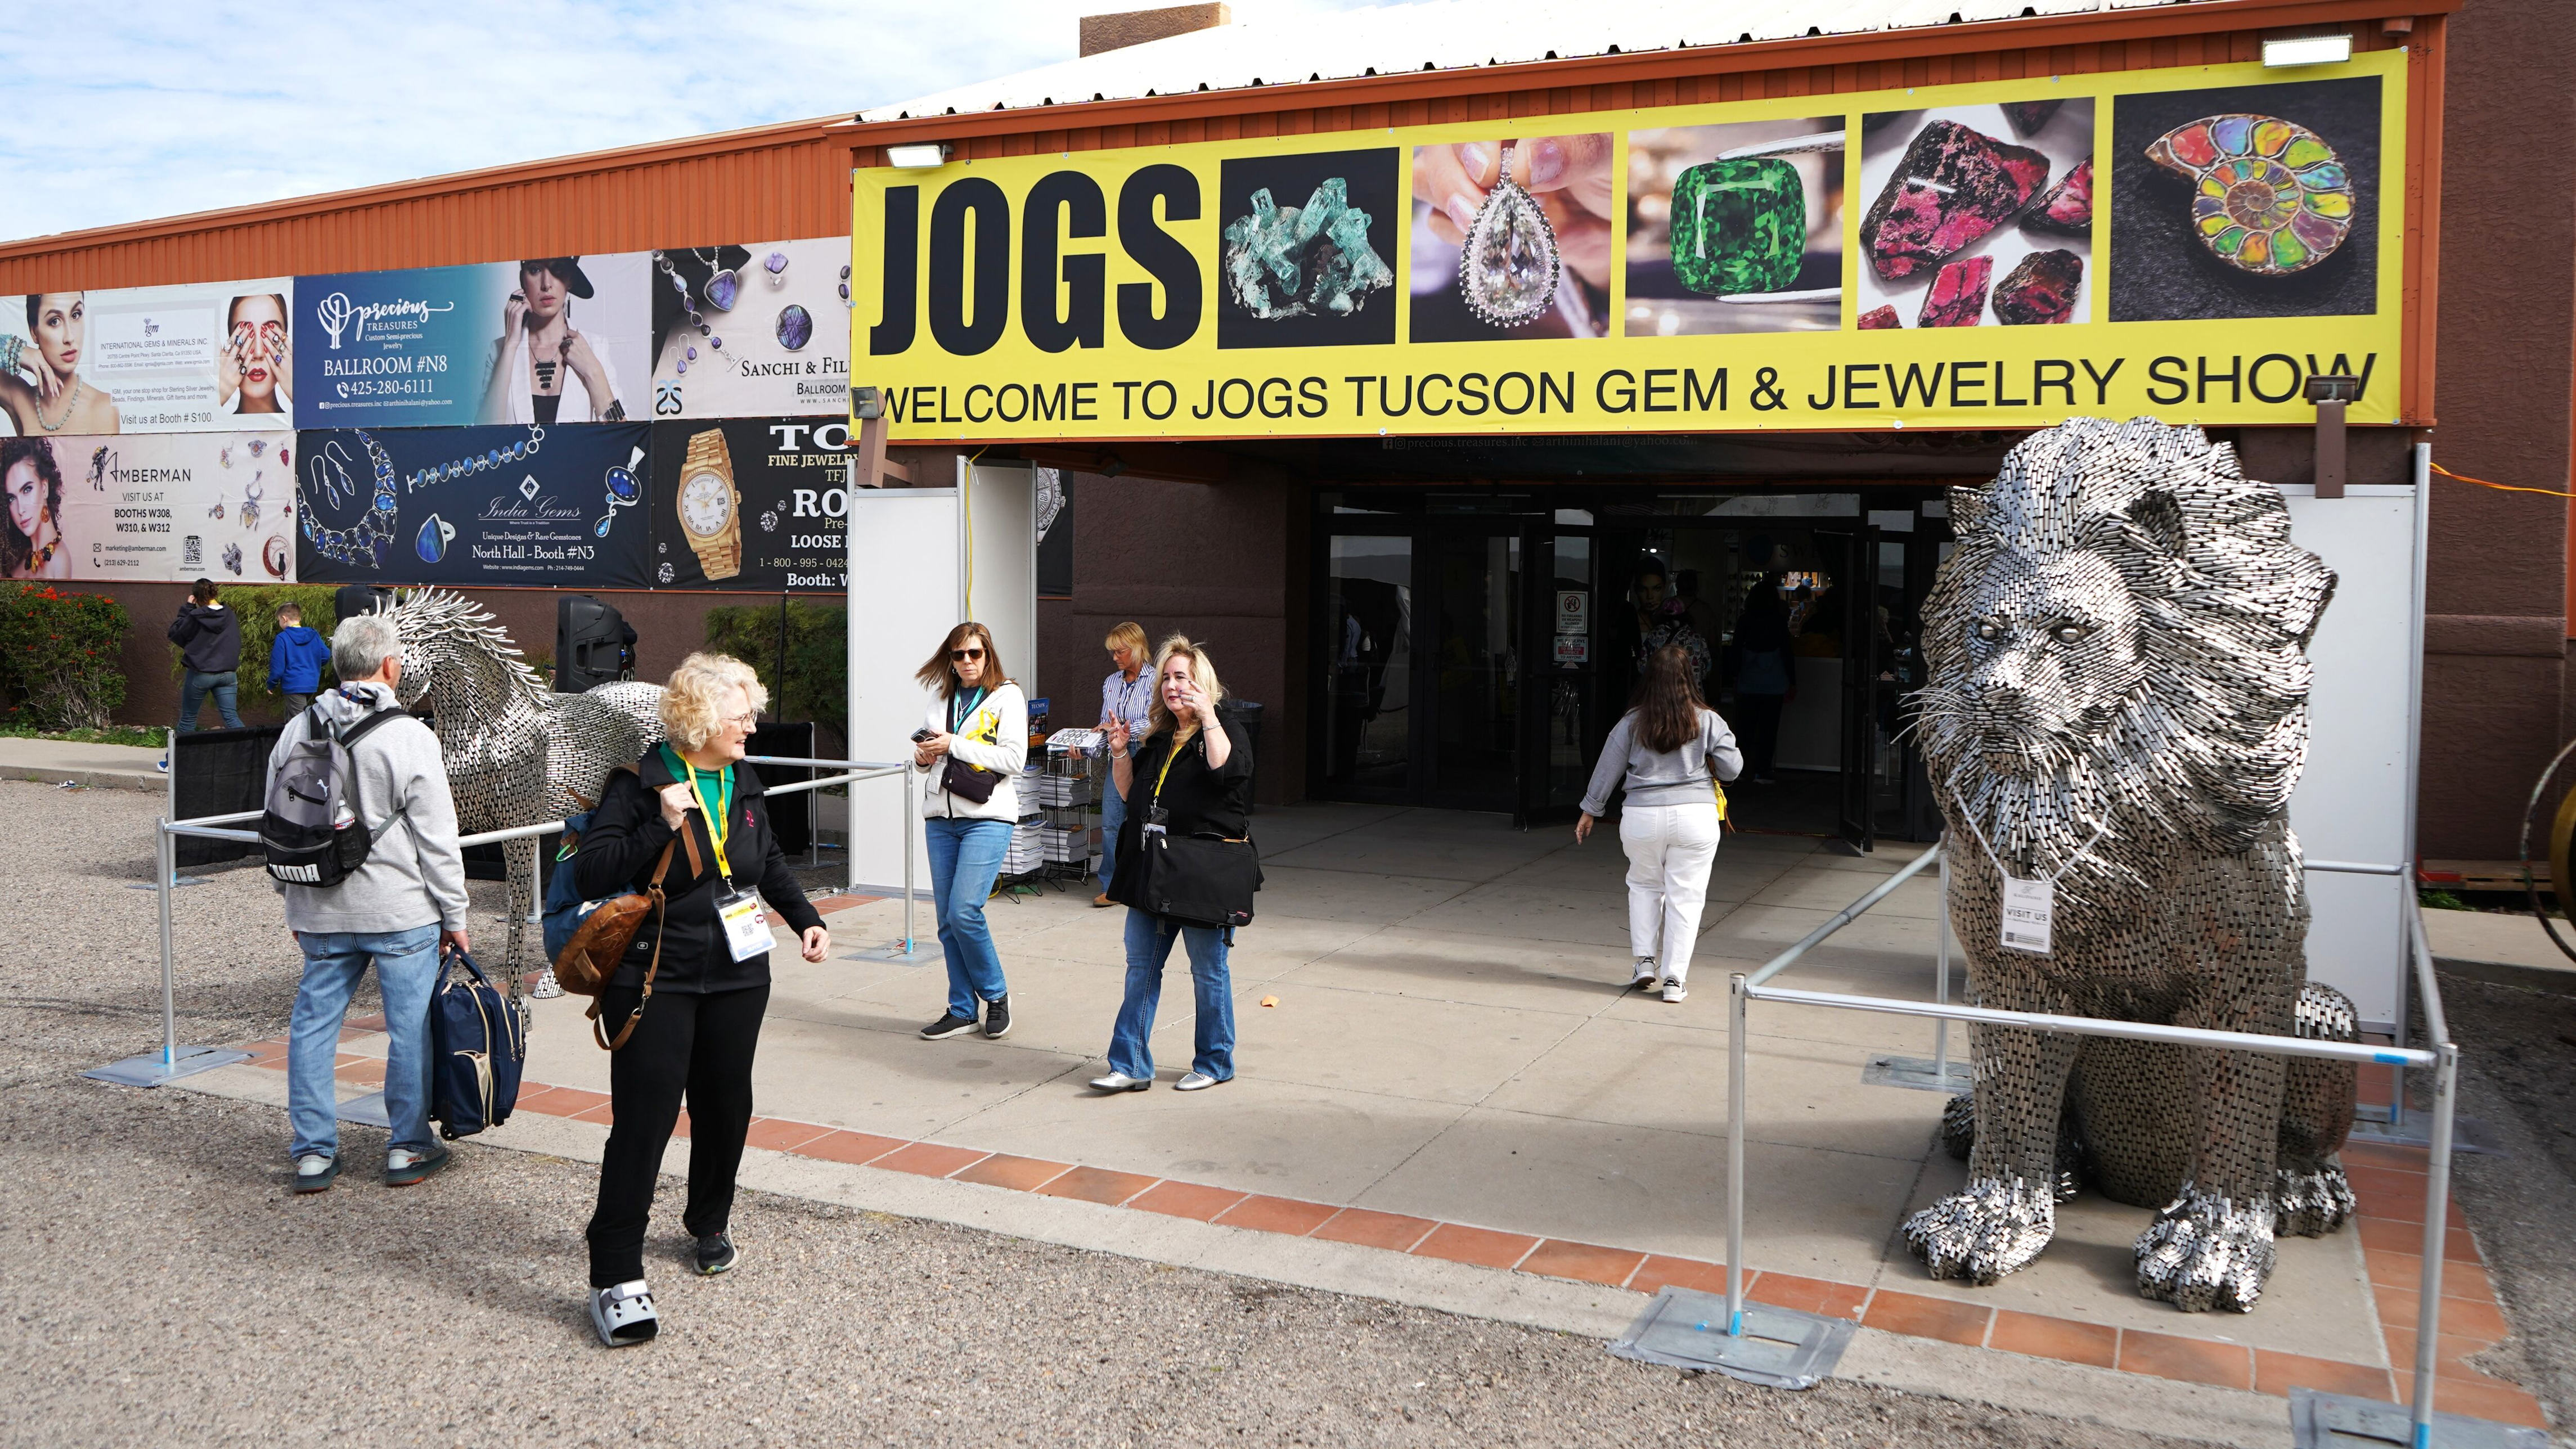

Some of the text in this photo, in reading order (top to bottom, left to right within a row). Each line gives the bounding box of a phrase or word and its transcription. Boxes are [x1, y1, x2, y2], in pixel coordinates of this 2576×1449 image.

[870, 164, 1202, 356] JOGS
[357, 298, 453, 341] precious
[367, 321, 417, 331] TREASURES
[145, 325, 159, 338] igm
[324, 355, 447, 376] BALLROOM #N8
[741, 357, 850, 376] SANCHI & FIL
[351, 379, 433, 395] 425-280-6111
[797, 382, 846, 395] BALLROOM
[882, 353, 2377, 423] WELCOME TO JOGS TUCSON GEM & JEWELRY SHOW
[330, 401, 382, 410] precious.treasures.inc
[120, 415, 137, 424] Visit
[150, 415, 157, 424] at
[159, 413, 182, 423] Booth
[184, 413, 189, 422] #
[191, 412, 214, 422] S100.
[768, 454, 798, 466] FINE
[105, 452, 191, 483] AMBERMAN
[122, 493, 164, 501] VISIT US AT
[478, 496, 582, 518] India Gems
[115, 509, 172, 519] BOOTHS W308,
[116, 524, 170, 533] W310, & W312
[483, 532, 503, 541] Unique
[505, 532, 527, 542] Designs
[528, 532, 534, 540] &
[550, 532, 582, 541] Gemstones
[791, 534, 841, 548] LOOSE
[472, 545, 501, 559] North
[503, 545, 525, 559] Hall
[534, 545, 565, 559] Booth
[567, 546, 595, 560] #N3
[760, 557, 764, 566] 1
[774, 557, 791, 567] 800
[799, 558, 817, 568] 995
[787, 573, 835, 586] Booth:
[269, 863, 321, 882] UMA
[2006, 908, 2048, 921] VISIT US
